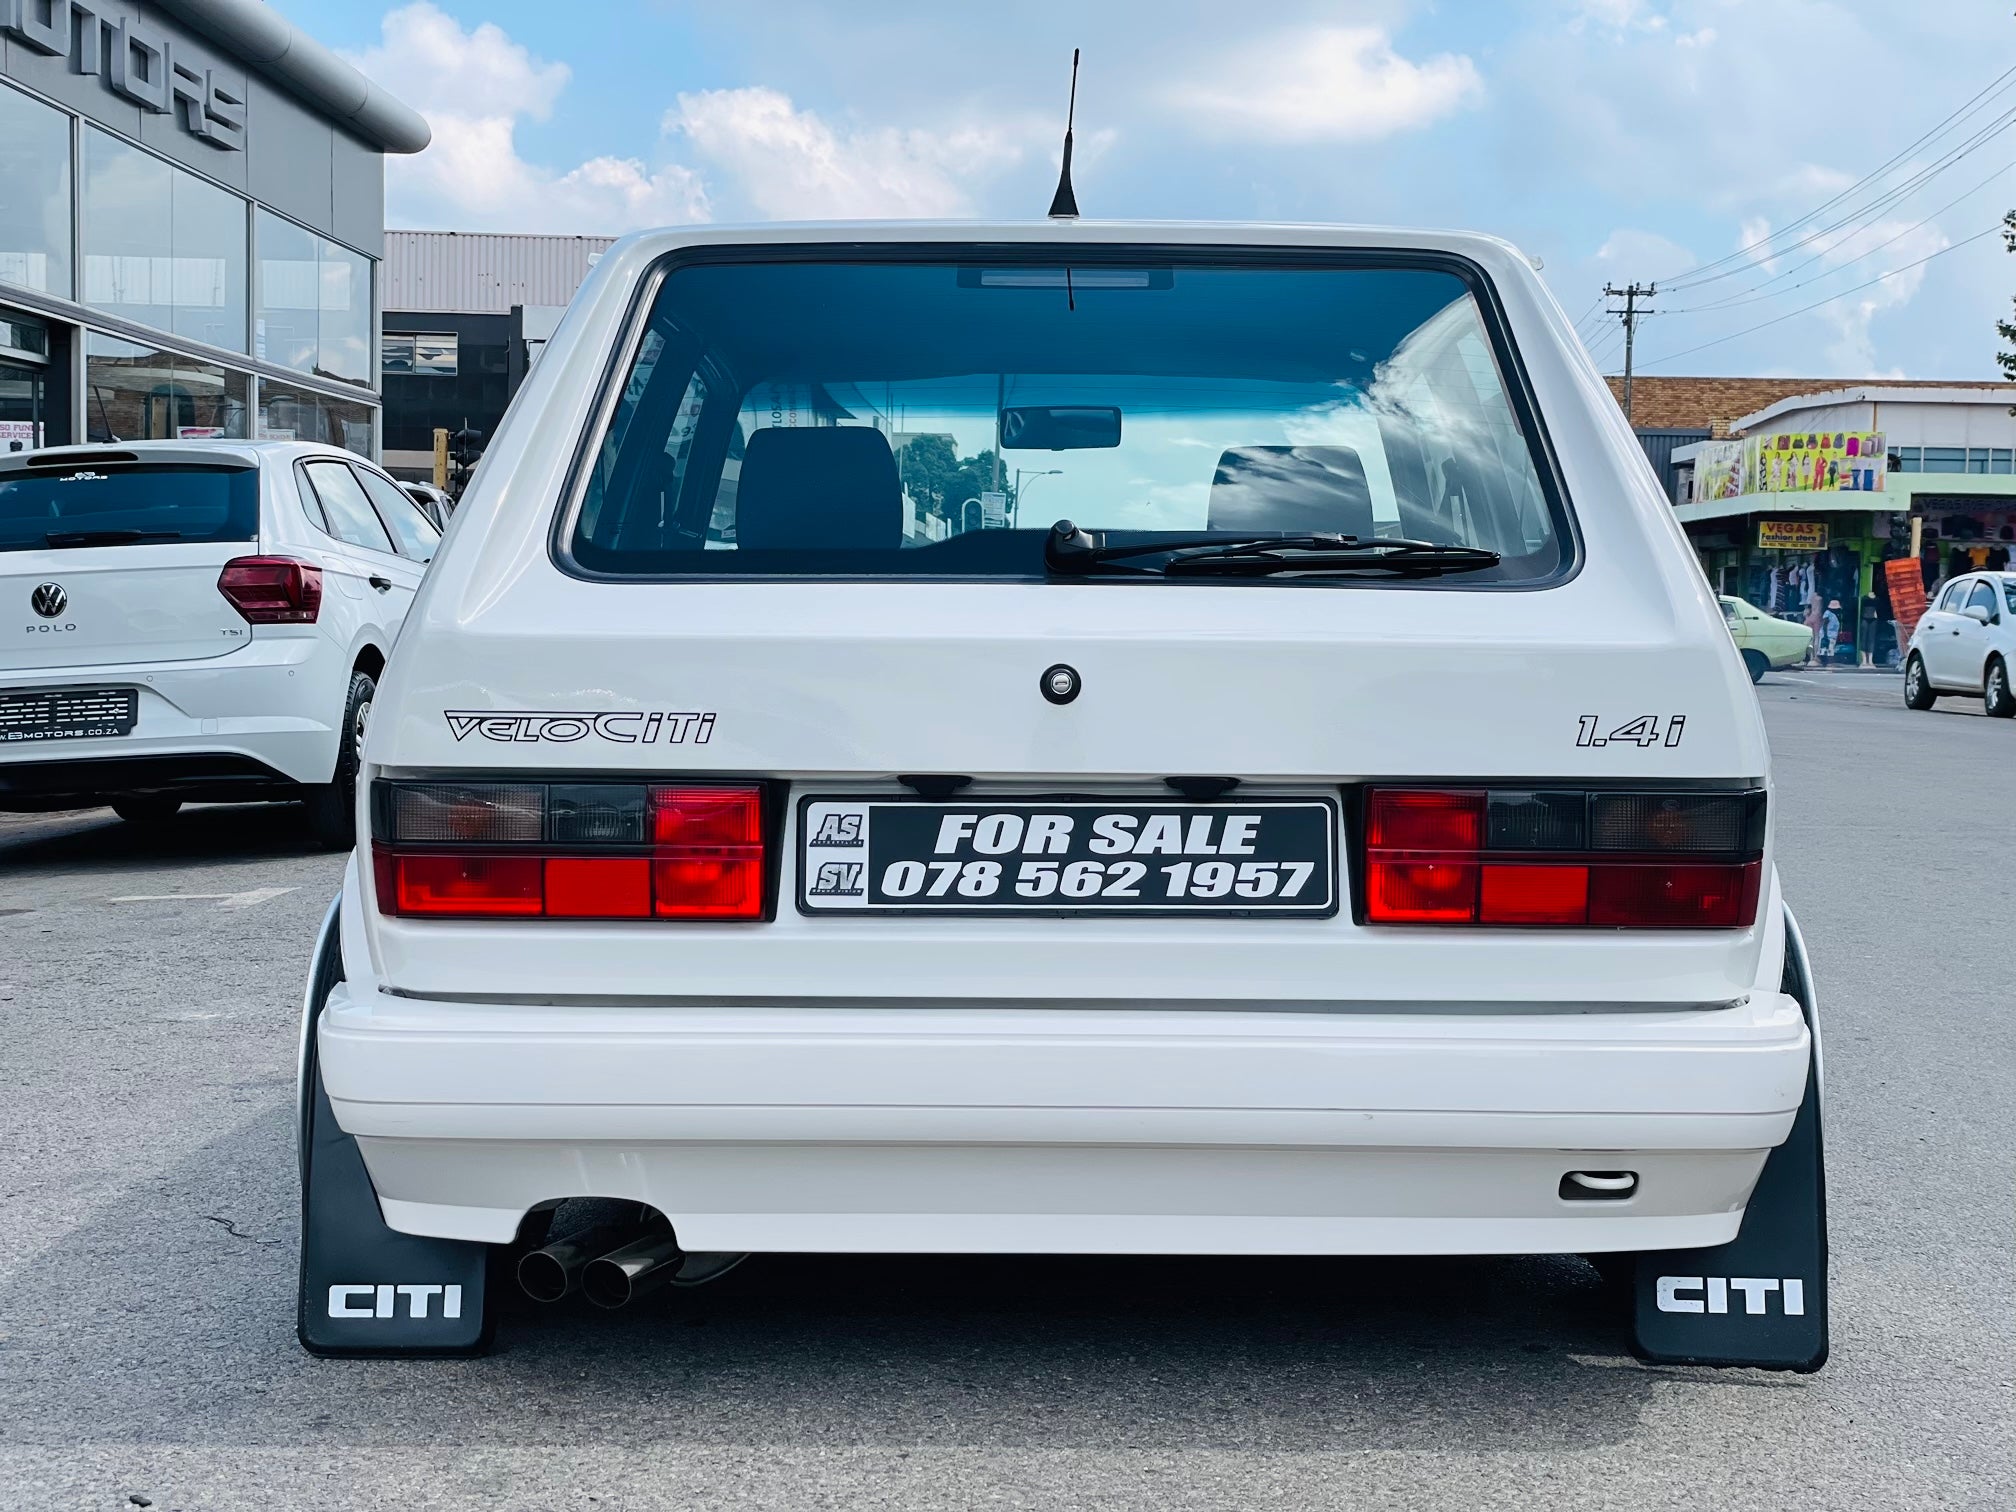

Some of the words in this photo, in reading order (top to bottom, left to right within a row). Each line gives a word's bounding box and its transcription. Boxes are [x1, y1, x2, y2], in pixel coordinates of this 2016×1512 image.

[1762, 532, 1793, 541] Fashion
[1796, 533, 1817, 542] store
[1766, 522, 1814, 533] VEGAS
[26, 623, 77, 634] POLO
[220, 628, 243, 636] TSI
[933, 814, 1074, 854] FOR
[1088, 814, 1262, 854] SALE
[880, 860, 1003, 897] 078
[1015, 861, 1147, 897] 562
[1160, 861, 1315, 897] 1957
[328, 1284, 462, 1318] CITI
[1656, 1276, 1805, 1316] CITI
